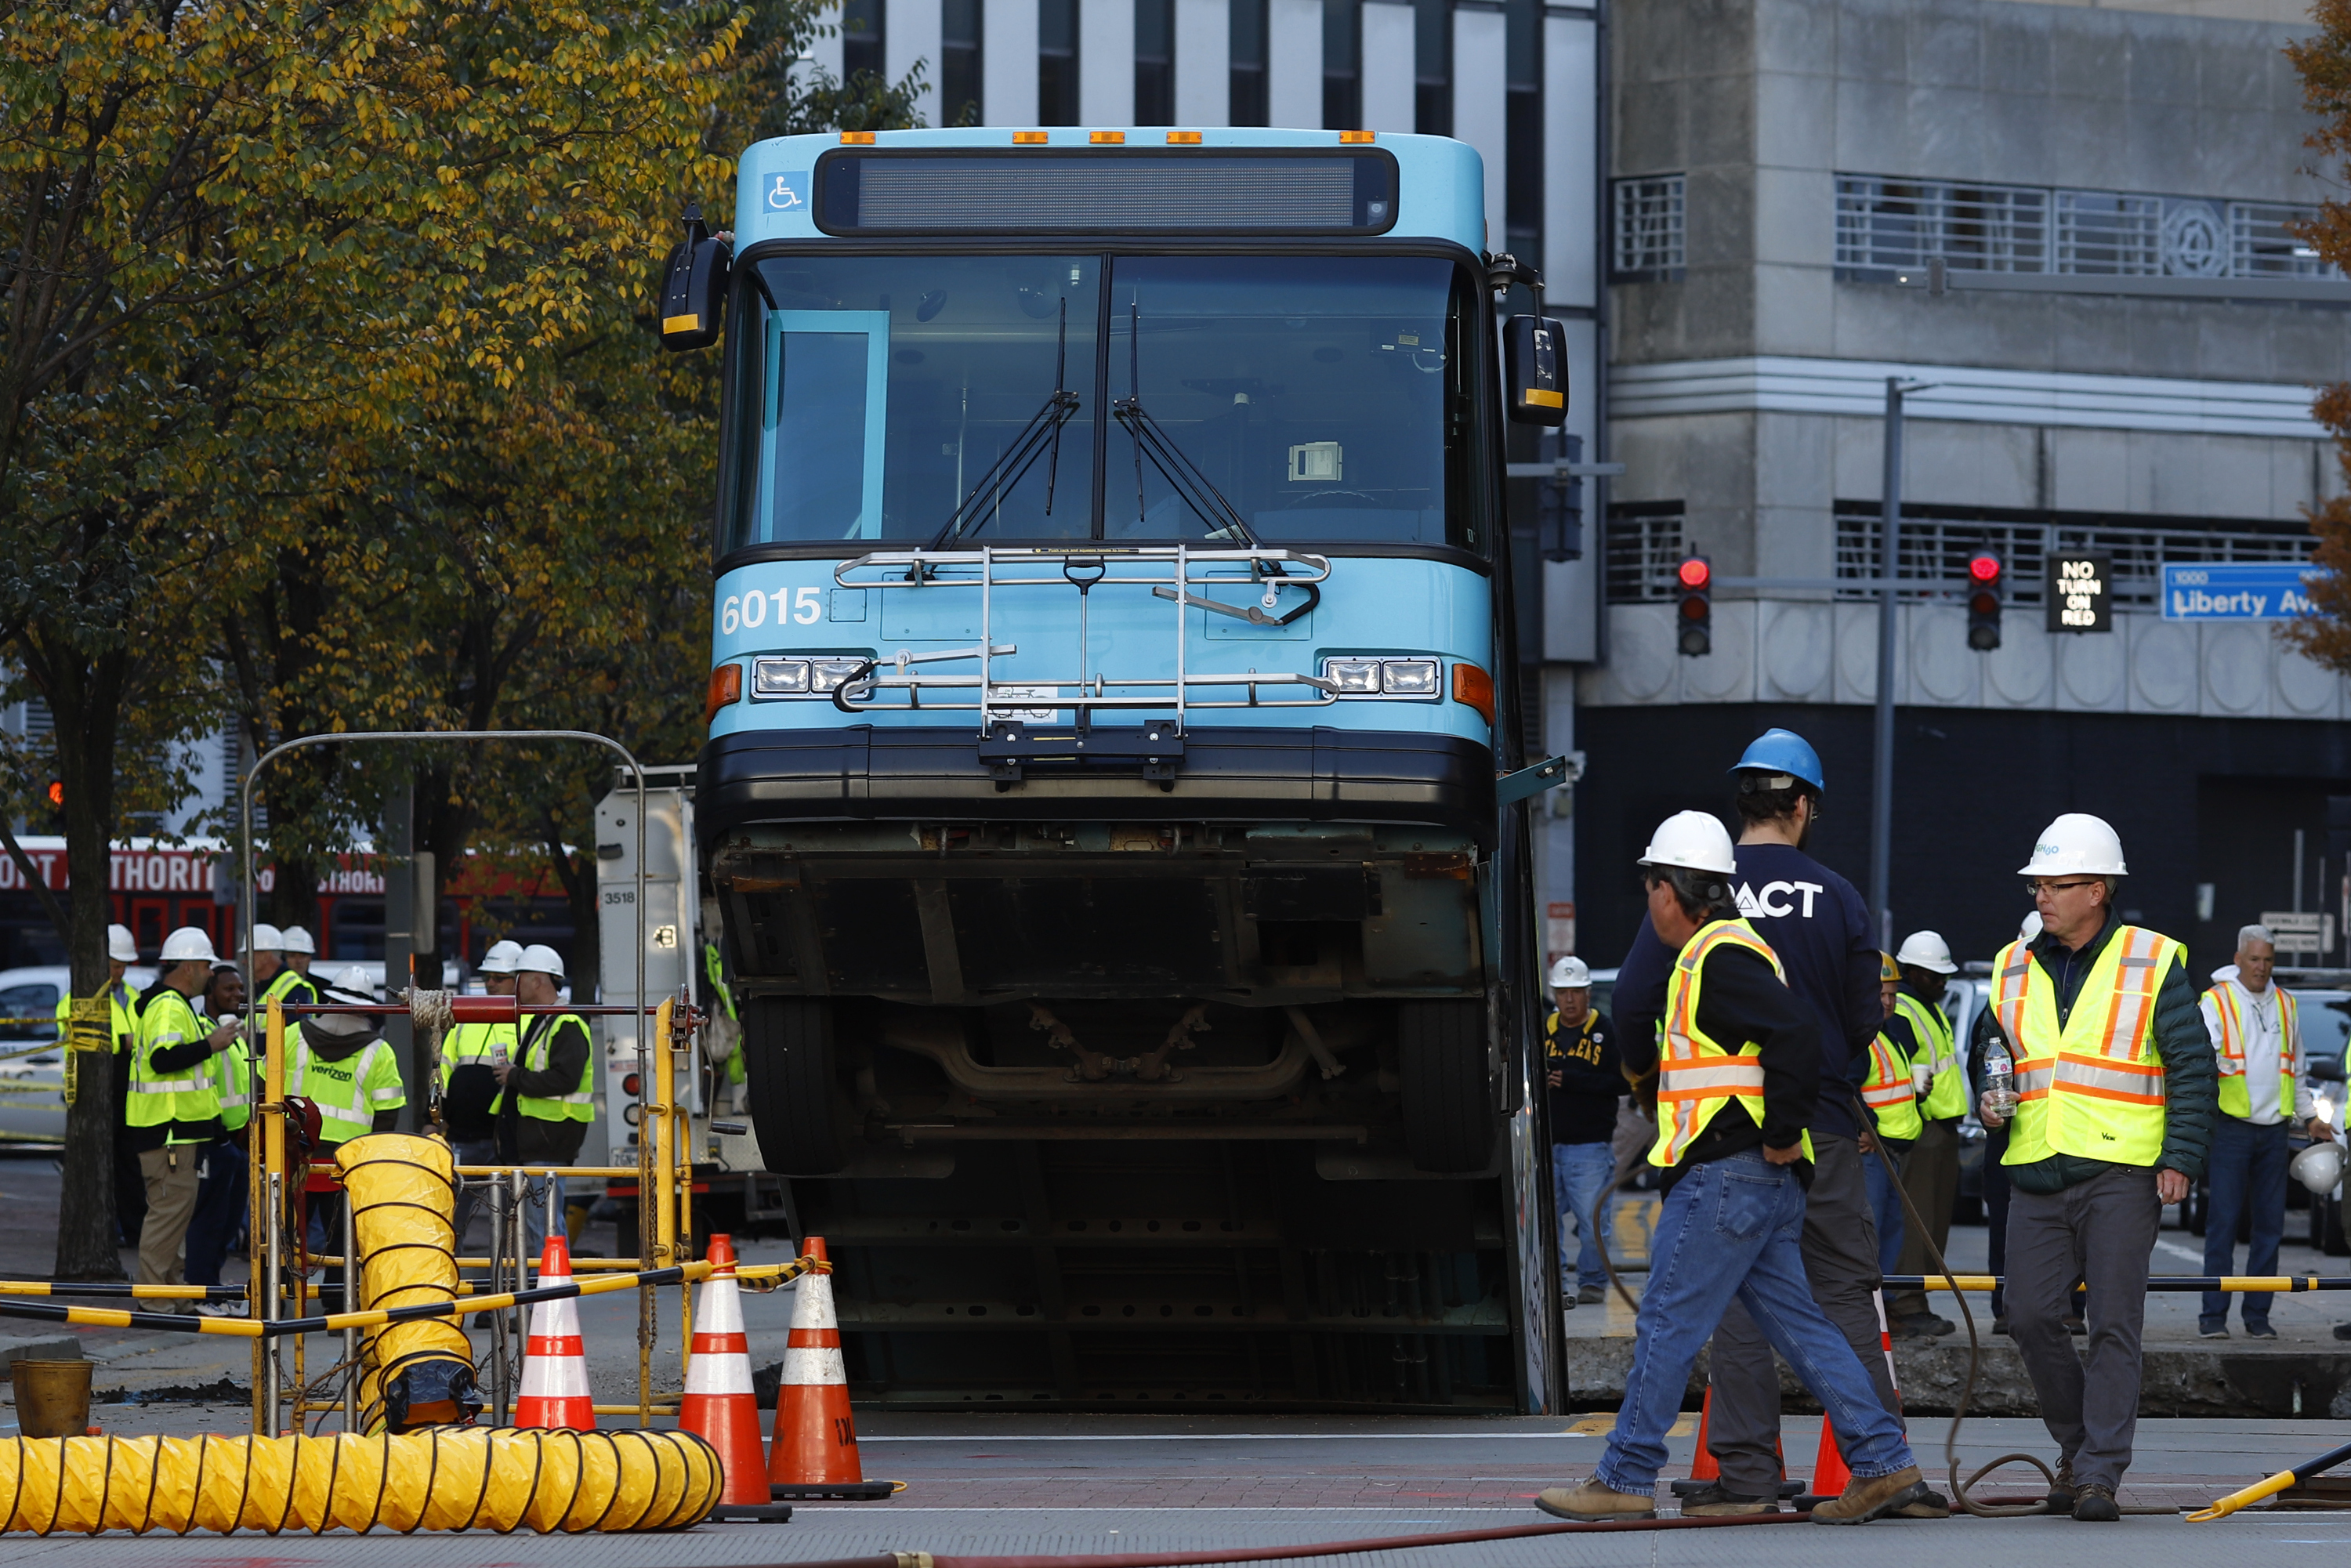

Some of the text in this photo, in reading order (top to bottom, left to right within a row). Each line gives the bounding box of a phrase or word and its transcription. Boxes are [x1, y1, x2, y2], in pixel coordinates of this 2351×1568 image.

[2061, 560, 2096, 580] NO
[2174, 570, 2208, 585] 1000
[2056, 578, 2102, 596] TURN
[2066, 594, 2092, 610] ON
[2172, 588, 2267, 617] Liberty
[722, 587, 821, 636] 6015
[2061, 609, 2096, 626] RED
[605, 892, 635, 904] 3518
[1727, 880, 1824, 918] ACT
[311, 1065, 353, 1081] verizon
